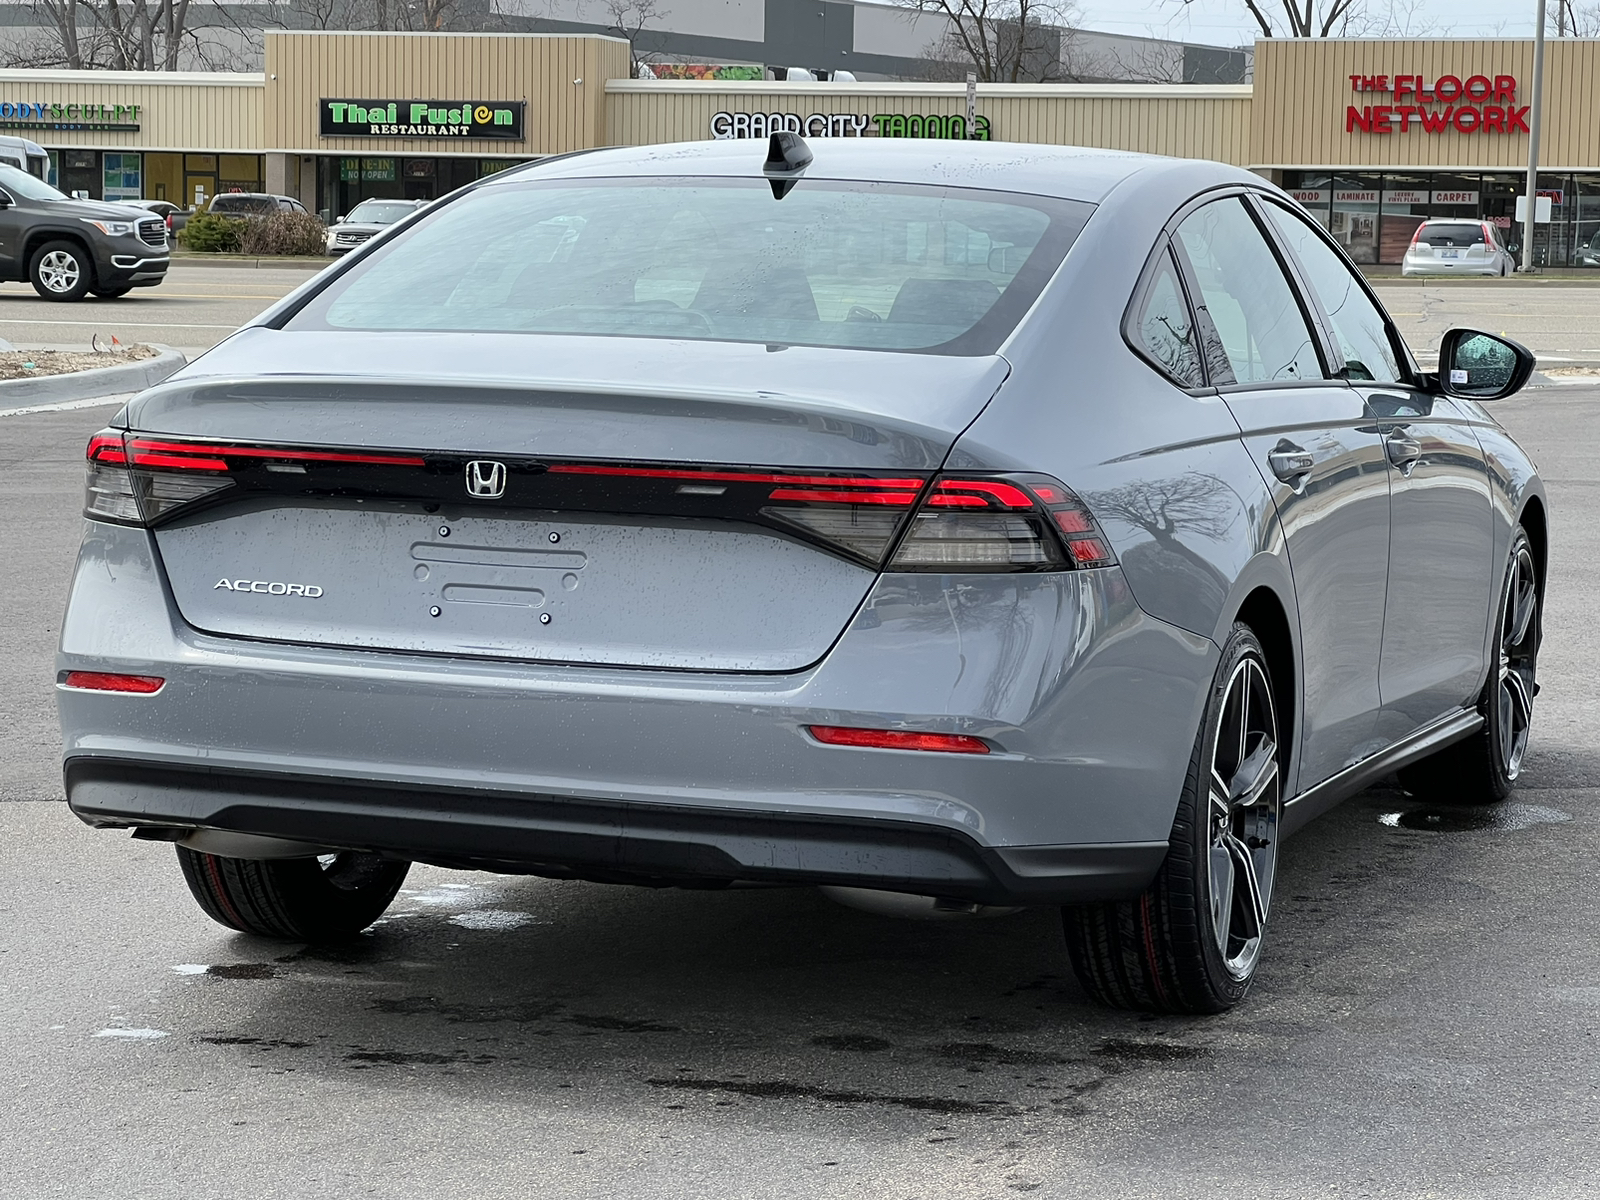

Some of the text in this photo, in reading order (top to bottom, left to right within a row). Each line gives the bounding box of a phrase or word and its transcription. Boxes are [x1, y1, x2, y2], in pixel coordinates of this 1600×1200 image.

[1349, 75, 1516, 102] THE FLOOR
[0, 102, 140, 121] ODYSCULPT
[328, 103, 513, 125] Thai Fusion
[709, 112, 991, 141] GRAND CITY TANNING
[1346, 106, 1530, 133] NETWORK
[370, 124, 470, 136] RESTAURANT
[345, 159, 390, 170] DINE-IN
[367, 171, 388, 179] OPEN
[1293, 192, 1319, 200] WOOD
[1336, 192, 1375, 200] LAMINATE
[1436, 193, 1472, 202] CARPET
[213, 578, 324, 598] ACCORD
